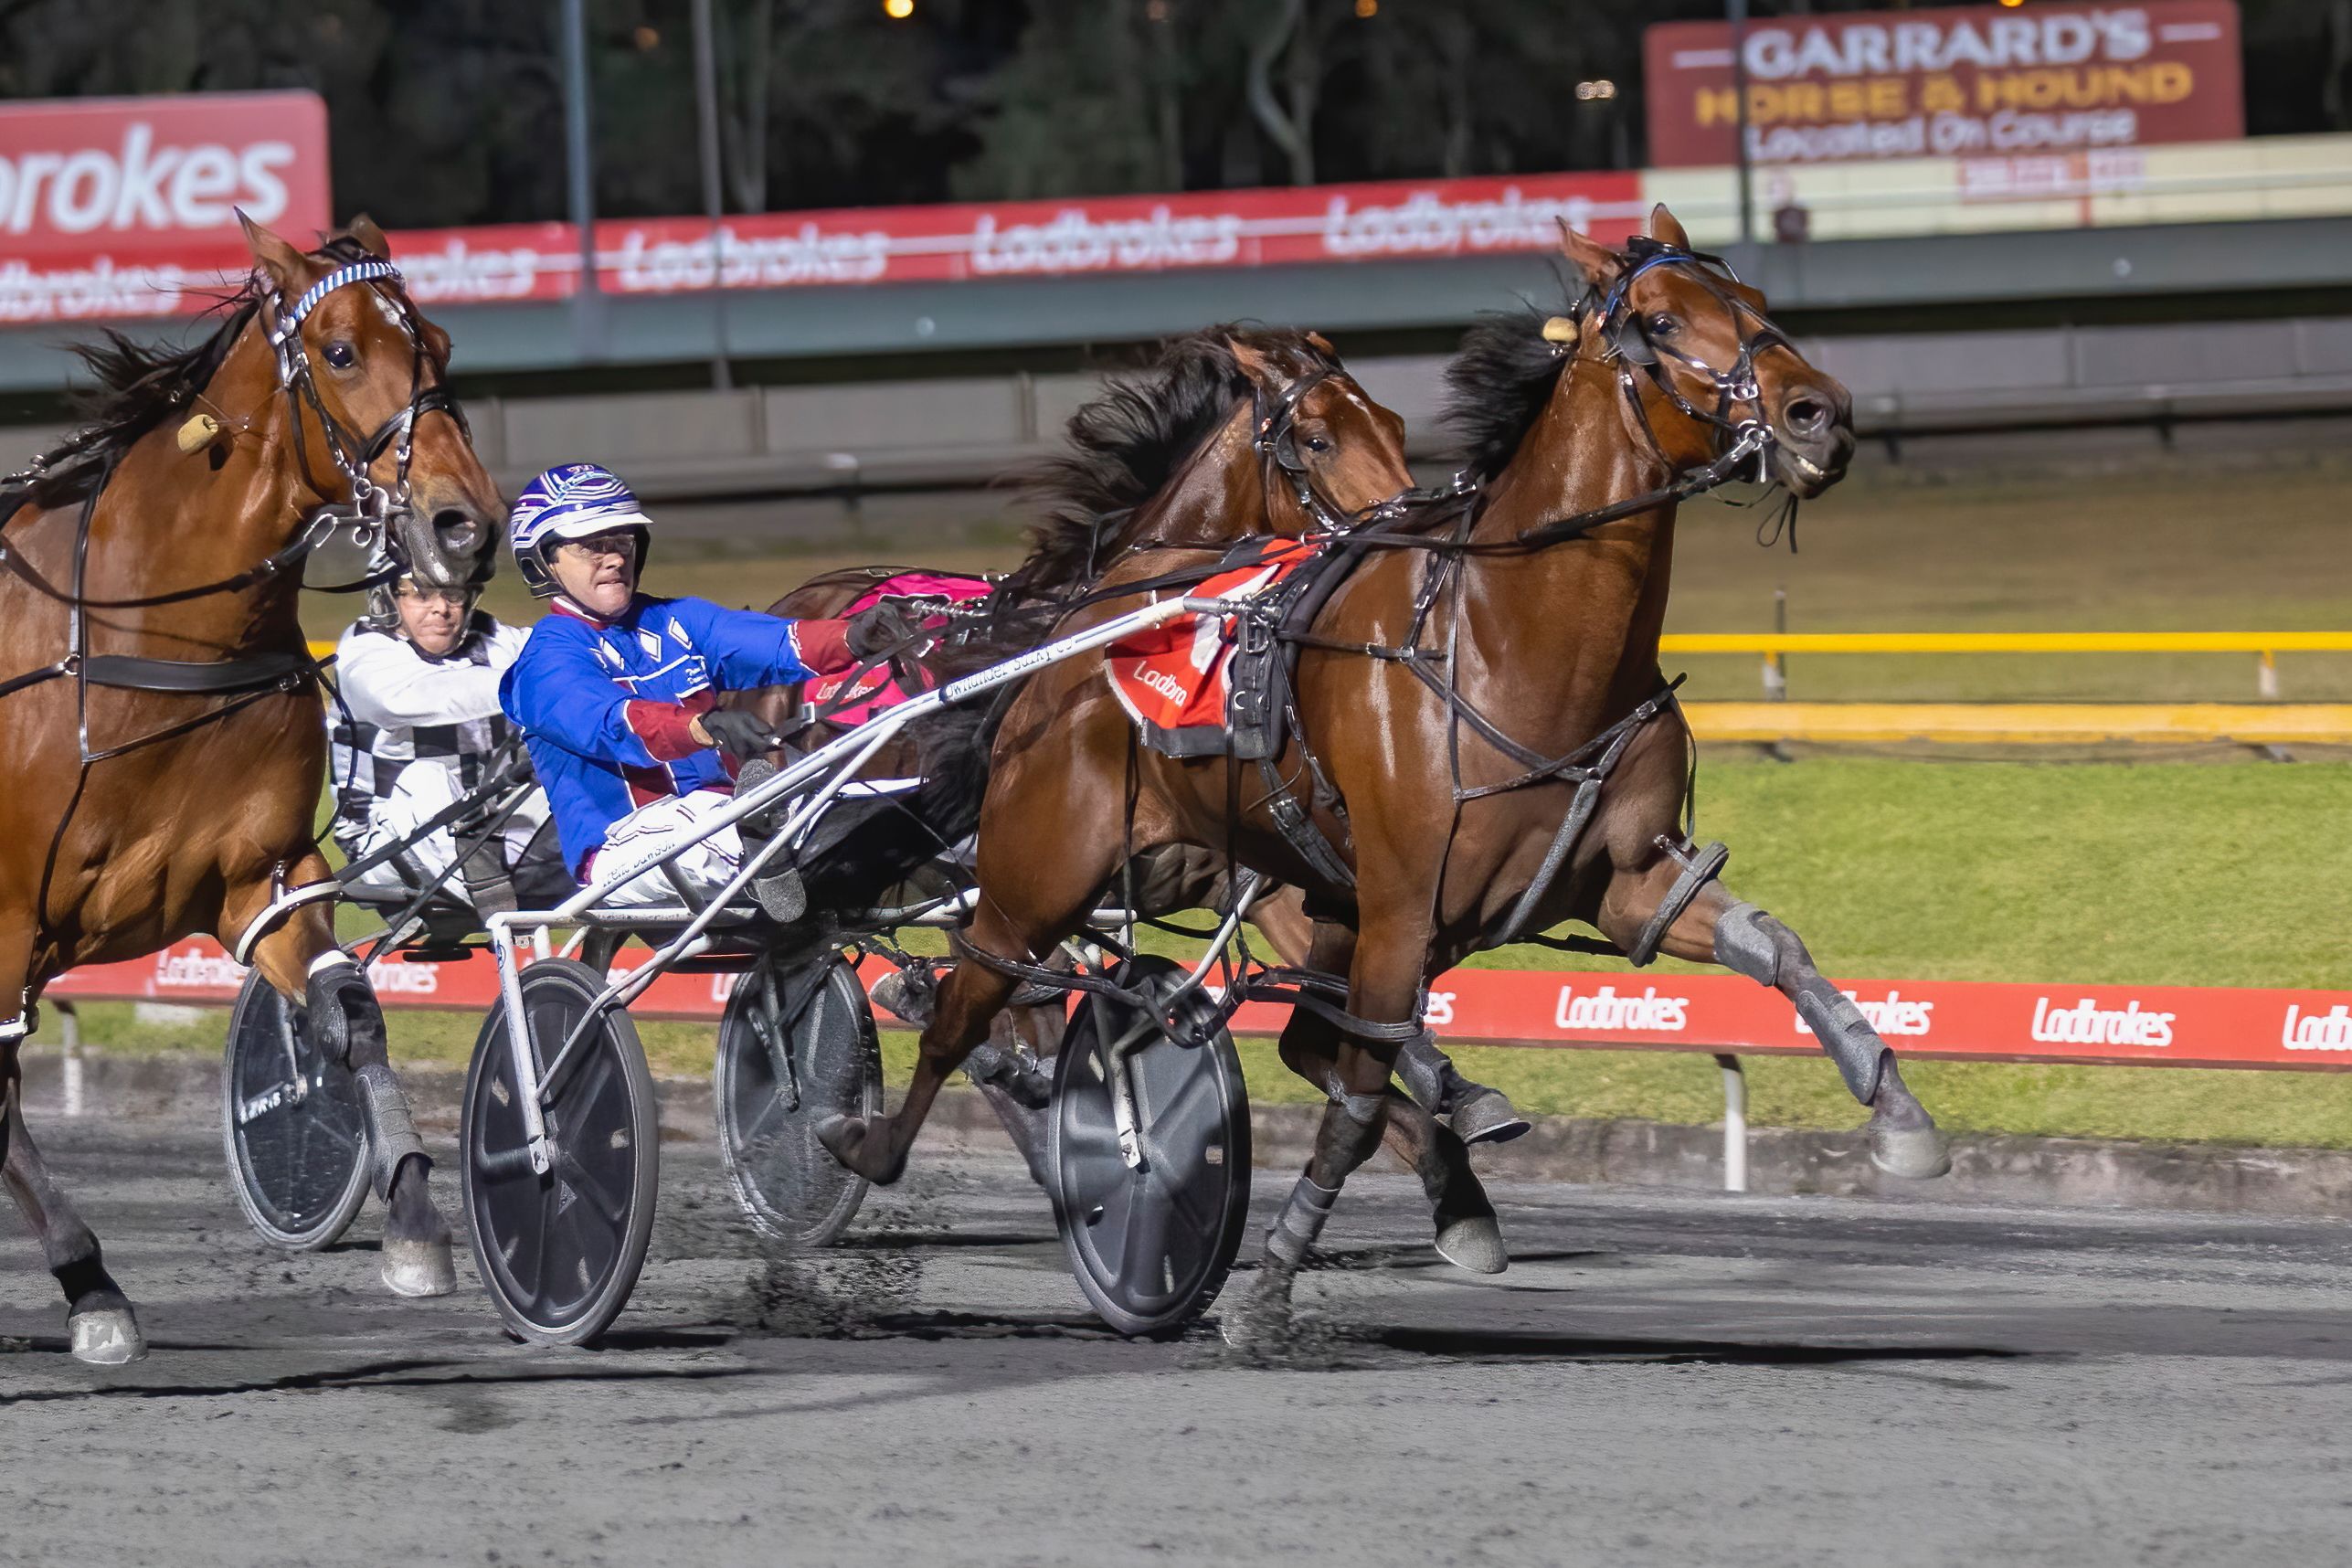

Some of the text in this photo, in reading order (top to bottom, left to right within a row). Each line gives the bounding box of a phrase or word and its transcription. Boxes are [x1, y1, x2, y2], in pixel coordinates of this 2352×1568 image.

[1742, 9, 2151, 79] GARRARD'S
[1695, 77, 1906, 125] HORSE
[1976, 61, 2192, 110] HOUND
[1988, 107, 2136, 150] Course
[970, 205, 1240, 273] Ladbrokes
[156, 948, 250, 985] Ladbroke
[1556, 985, 1690, 1031] Ladbrokes
[2030, 997, 2176, 1047] Ladbrokes
